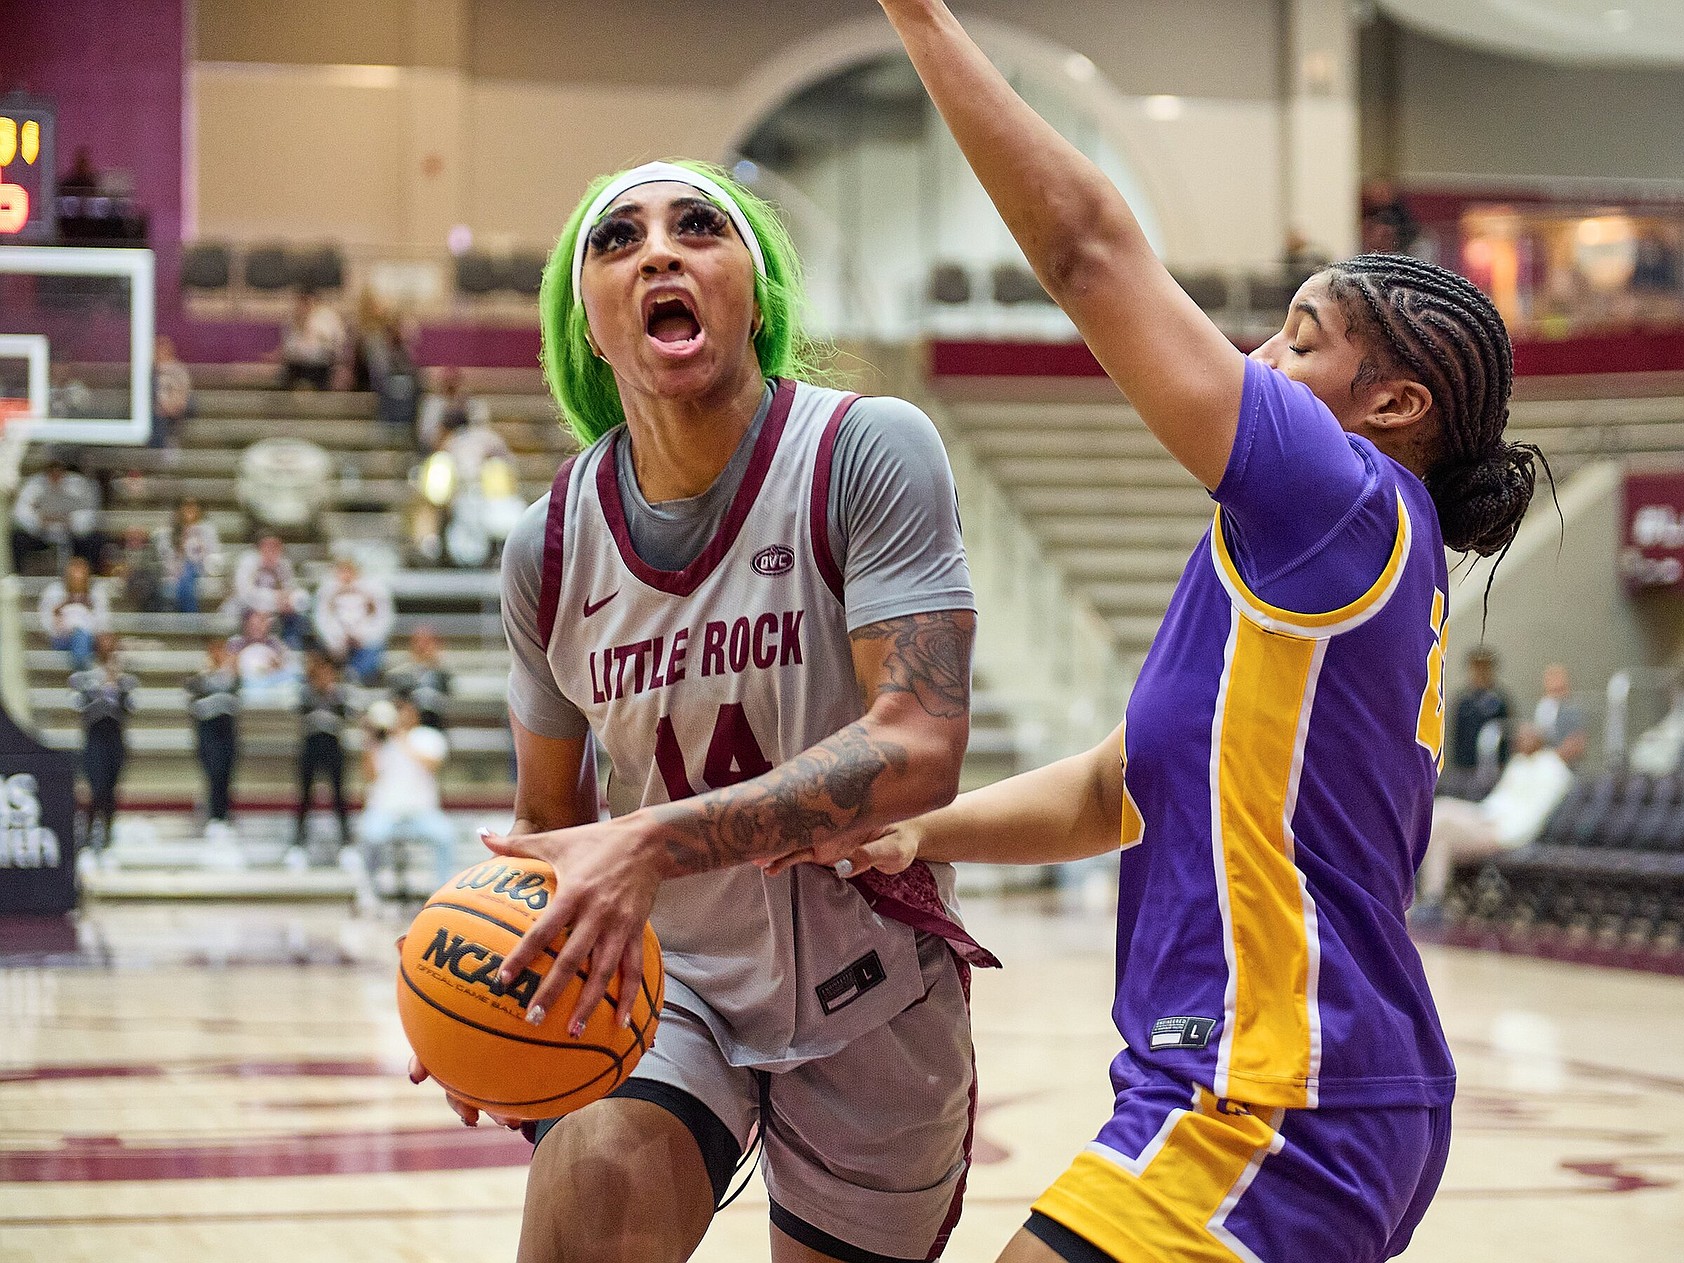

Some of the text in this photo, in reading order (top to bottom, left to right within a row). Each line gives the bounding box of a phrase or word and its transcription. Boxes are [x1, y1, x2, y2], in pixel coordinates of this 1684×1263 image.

[589, 609, 805, 704] LITTLE ROCK
[654, 701, 774, 802] 14
[422, 926, 542, 1010] NCAA
[862, 968, 873, 981] L
[1190, 1024, 1199, 1039] L
